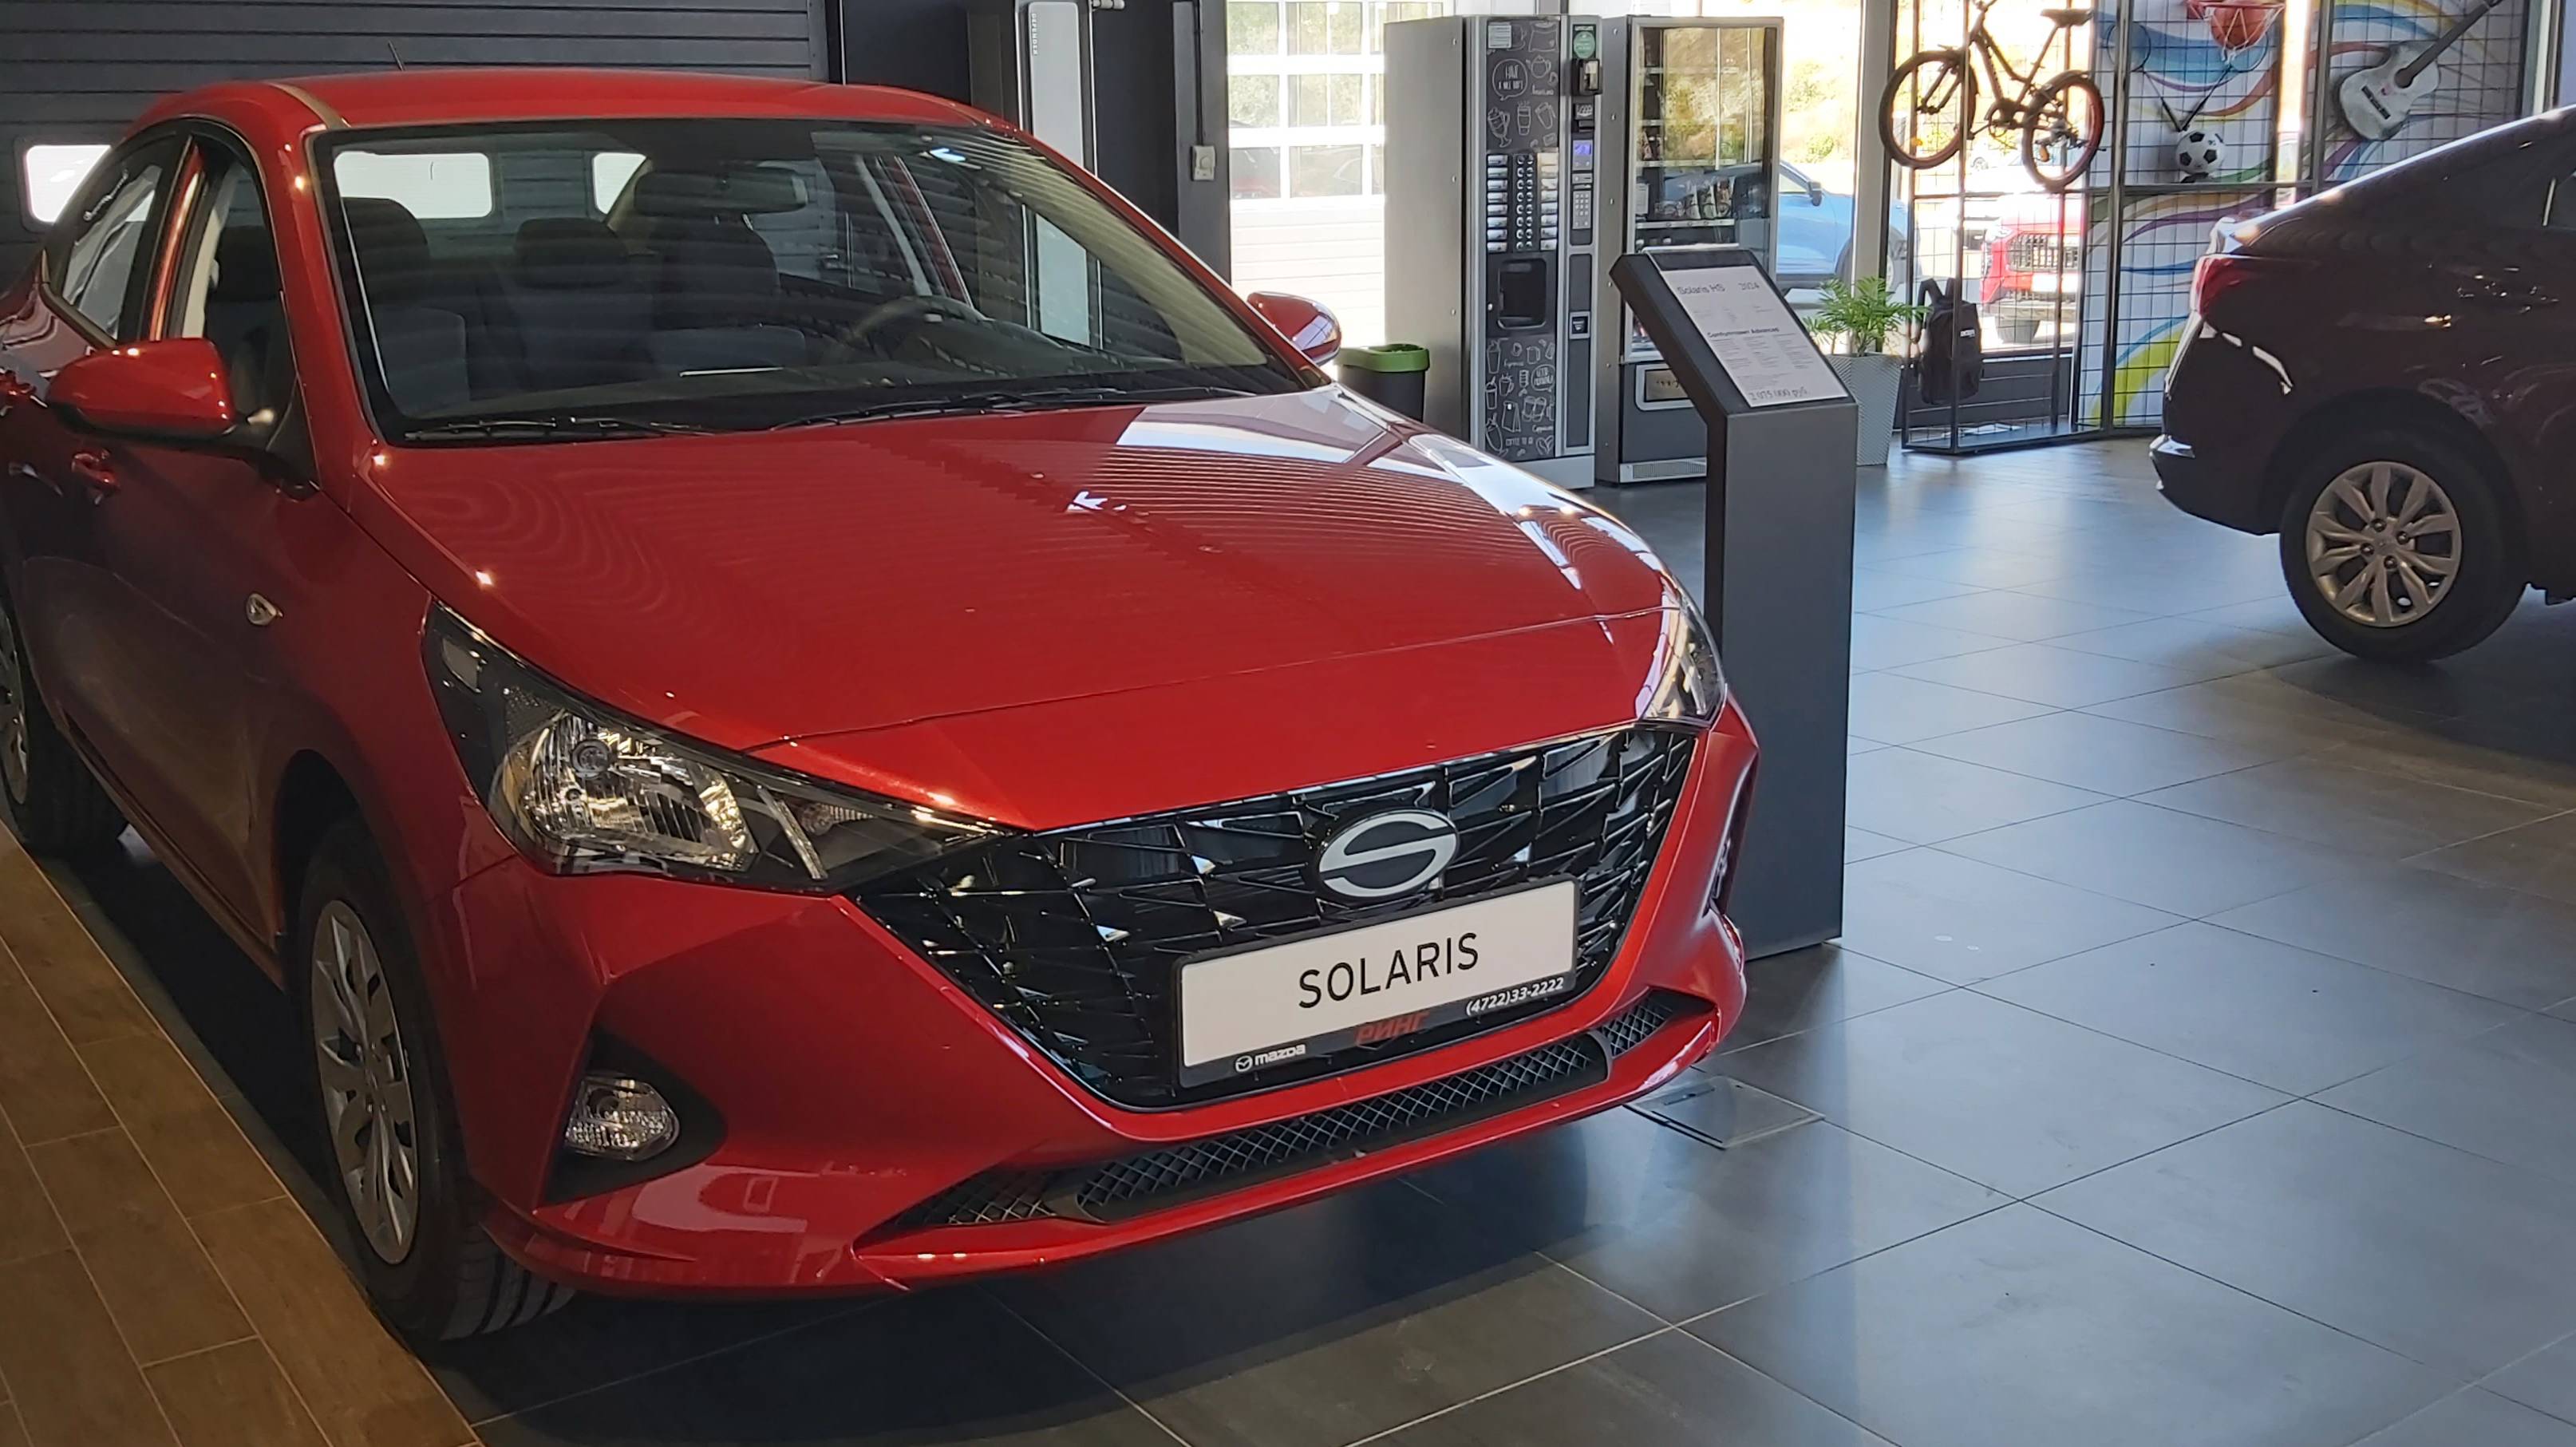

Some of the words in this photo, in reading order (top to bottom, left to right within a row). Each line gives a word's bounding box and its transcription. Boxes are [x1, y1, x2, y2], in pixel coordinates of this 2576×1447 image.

[1298, 932, 1479, 1008] SOLARIS
[1466, 977, 1564, 1016] (4722)33-2222
[1357, 1010, 1431, 1043] РИНГ
